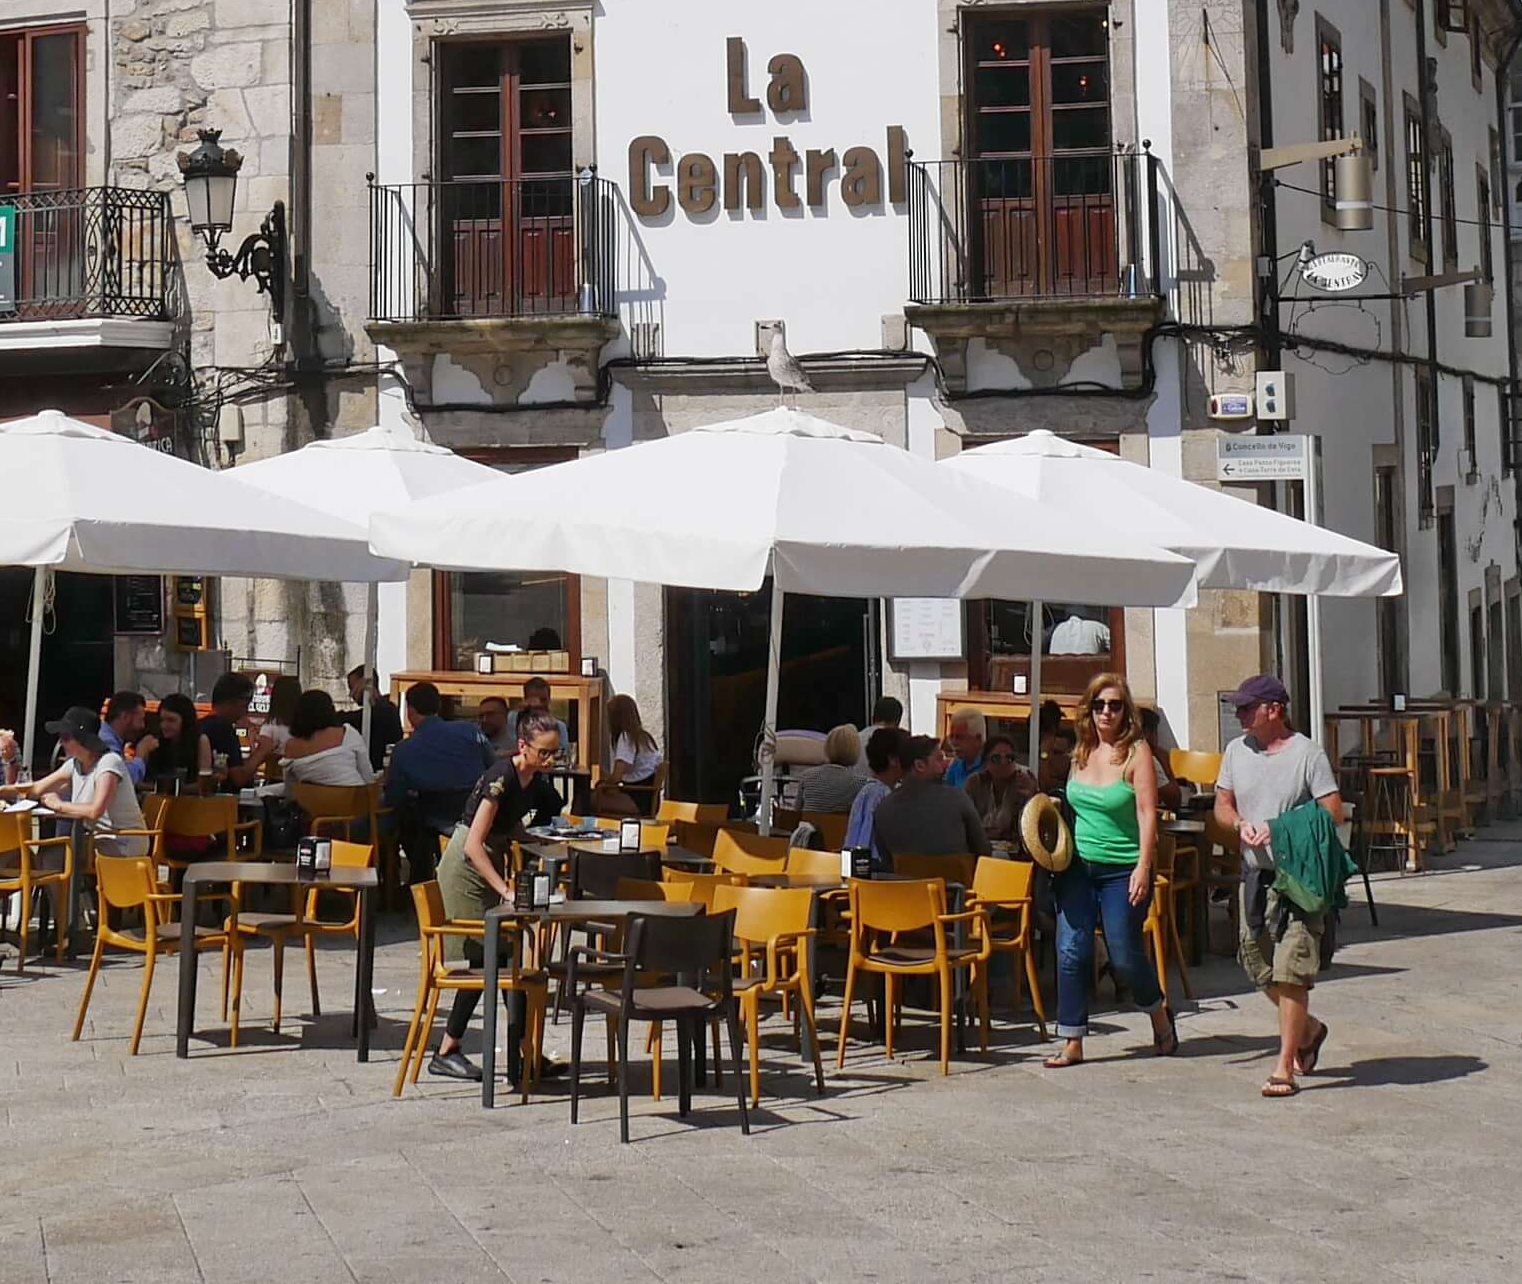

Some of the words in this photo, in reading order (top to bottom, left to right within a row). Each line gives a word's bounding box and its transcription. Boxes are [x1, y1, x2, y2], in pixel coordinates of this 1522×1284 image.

[726, 36, 808, 116] La
[628, 125, 907, 217] Central
[1278, 441, 1296, 452] Vigo
